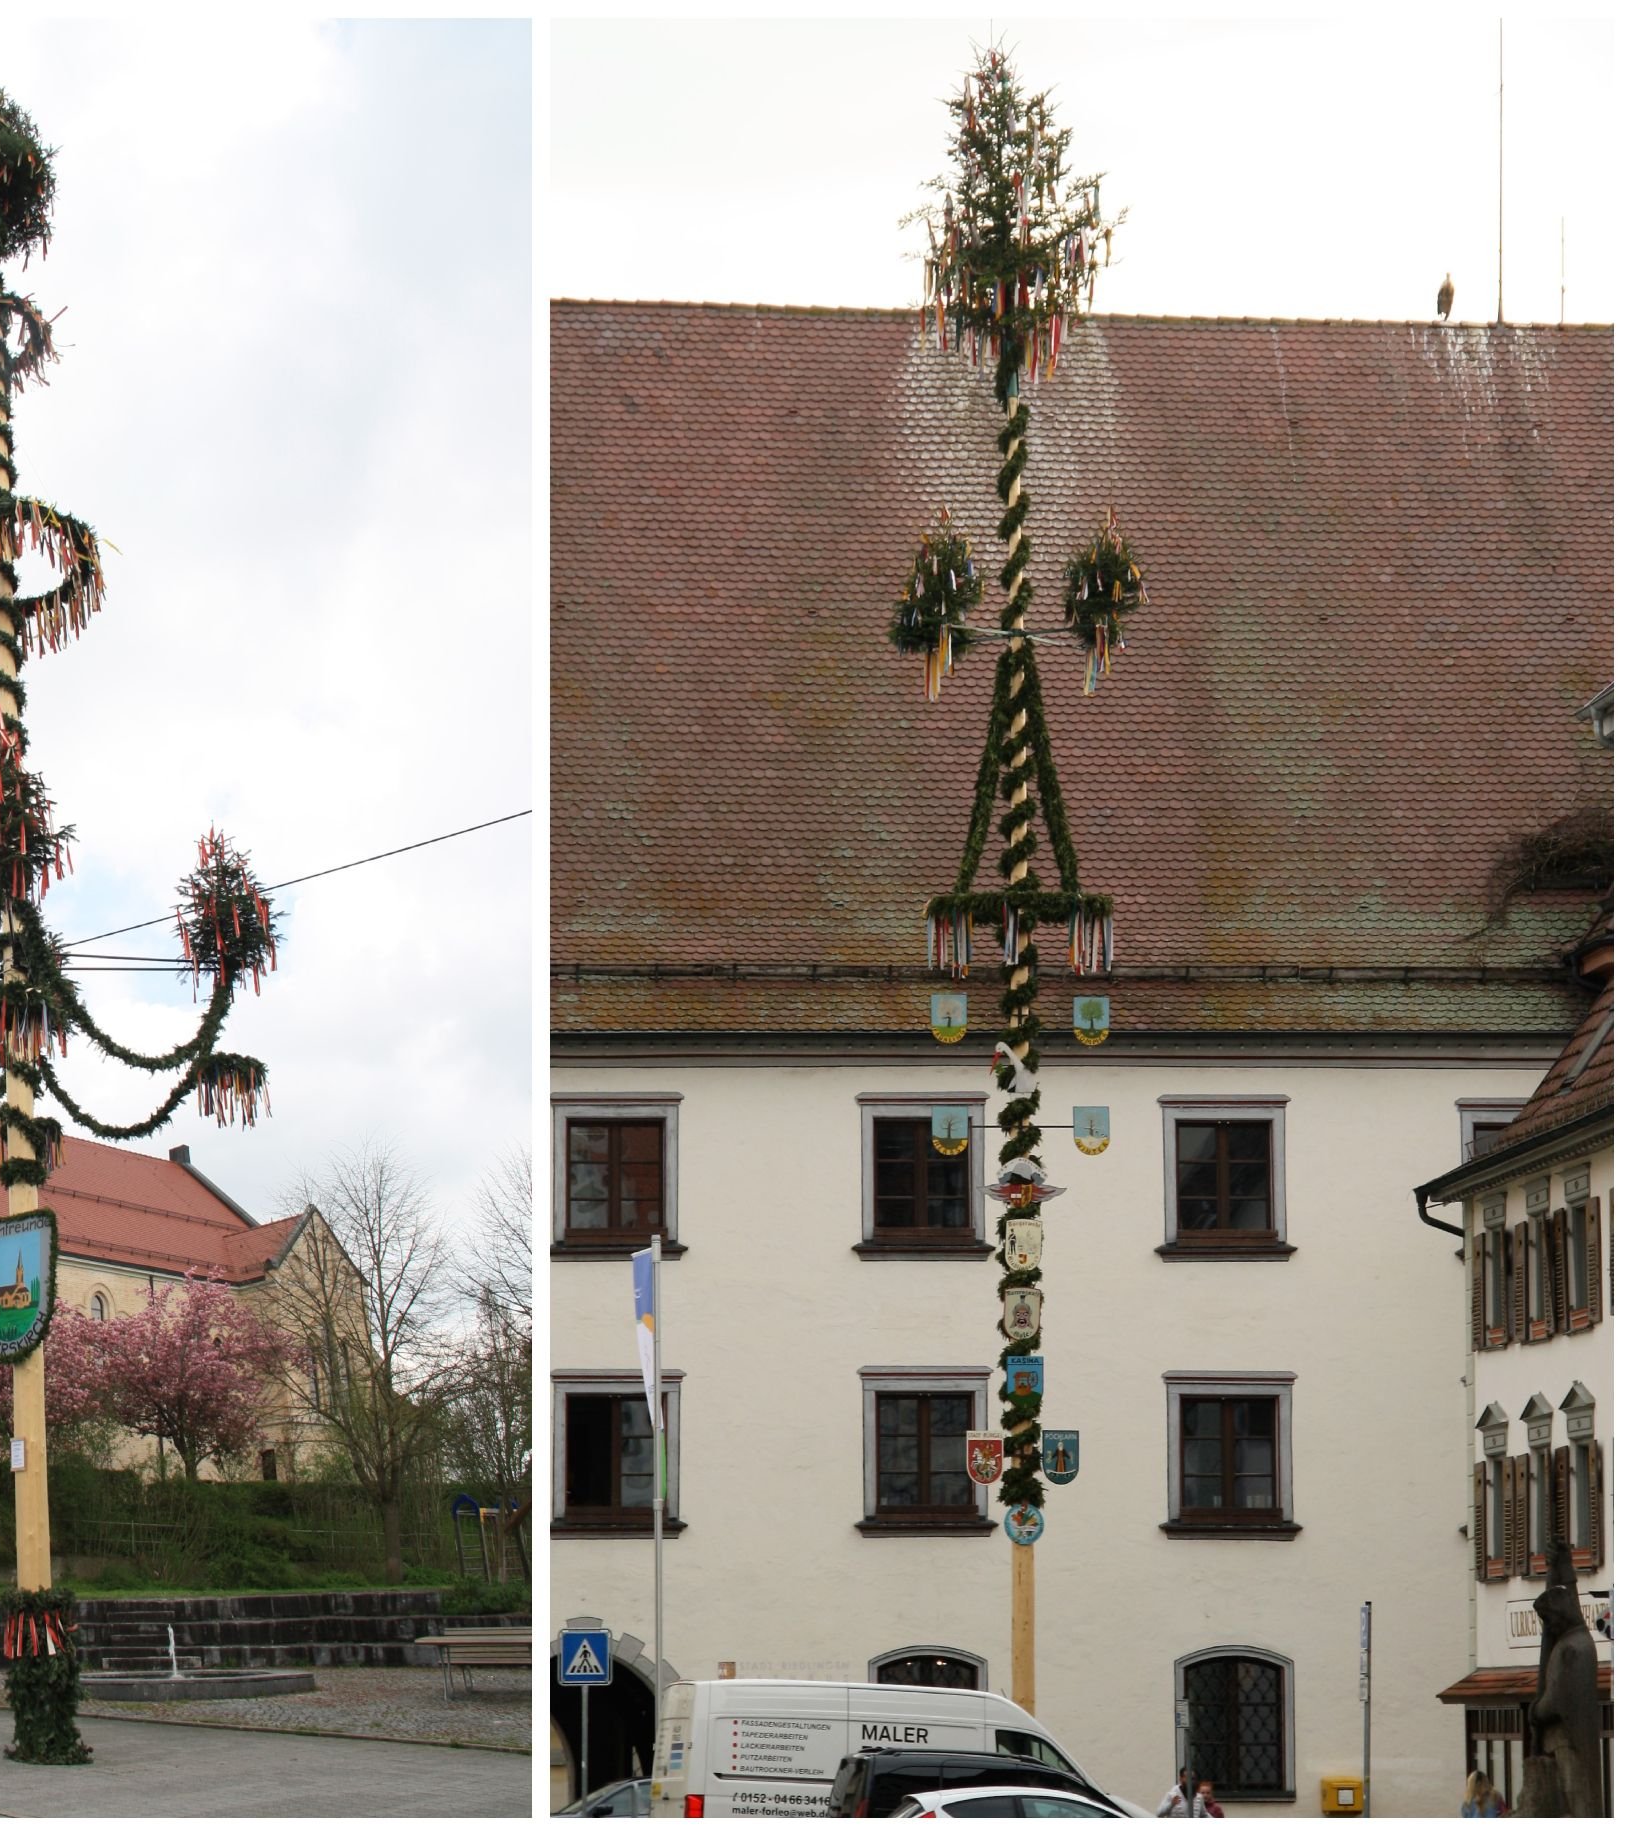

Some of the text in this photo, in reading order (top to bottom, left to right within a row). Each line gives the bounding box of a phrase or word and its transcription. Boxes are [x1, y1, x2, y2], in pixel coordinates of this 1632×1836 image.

[741, 1731, 808, 1740] TAPEZIERARBEITEN
[862, 1724, 928, 1744] MALER
[740, 1743, 805, 1752] LACKIERARBEITEN
[740, 1754, 792, 1763] PUTZARBEITEN
[740, 1792, 767, 1804] 0152
